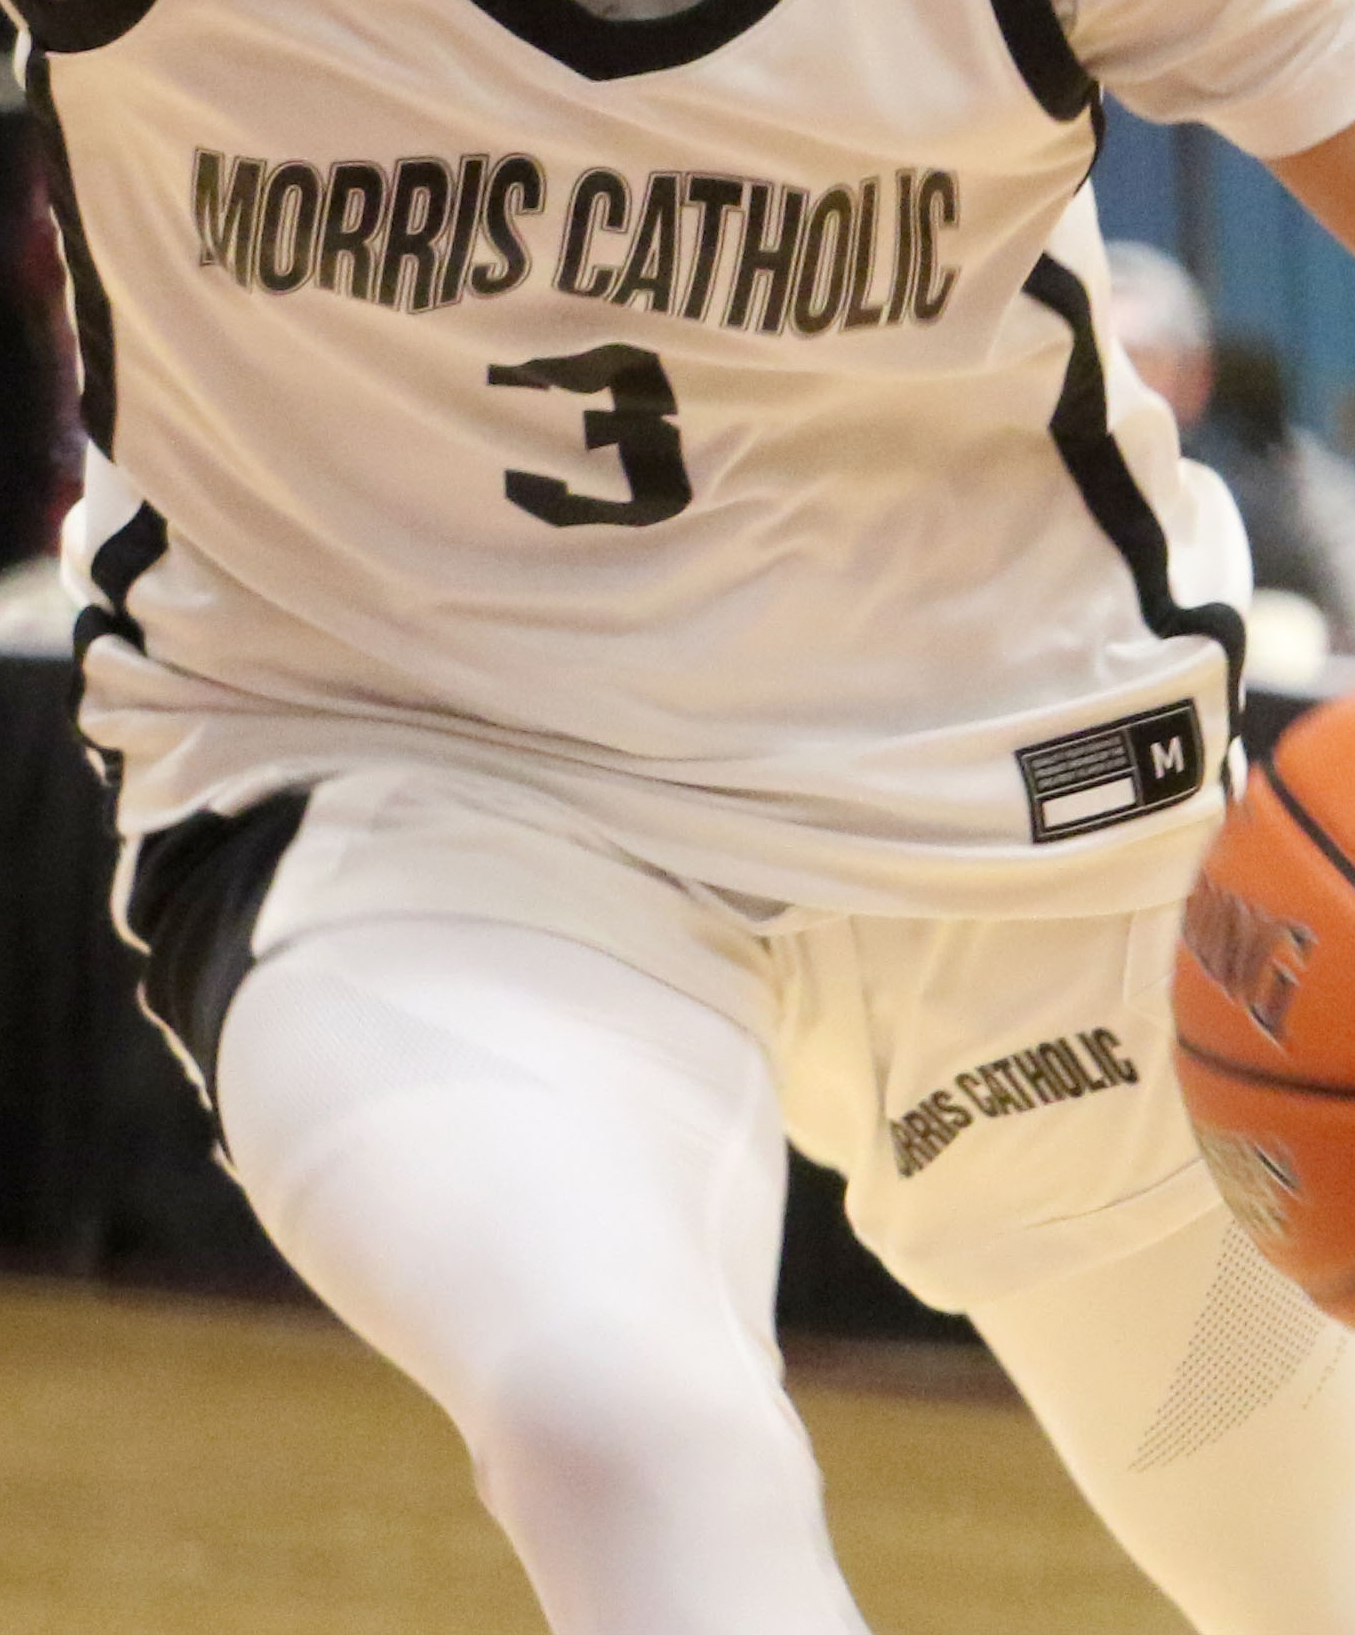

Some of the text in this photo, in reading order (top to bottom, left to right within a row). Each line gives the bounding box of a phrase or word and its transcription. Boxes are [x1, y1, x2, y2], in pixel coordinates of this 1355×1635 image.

[194, 147, 961, 341] MORRIS CATHOLIC
[487, 343, 693, 528] 3
[1150, 735, 1185, 780] M
[954, 1027, 1139, 1118] CATHOLIC
